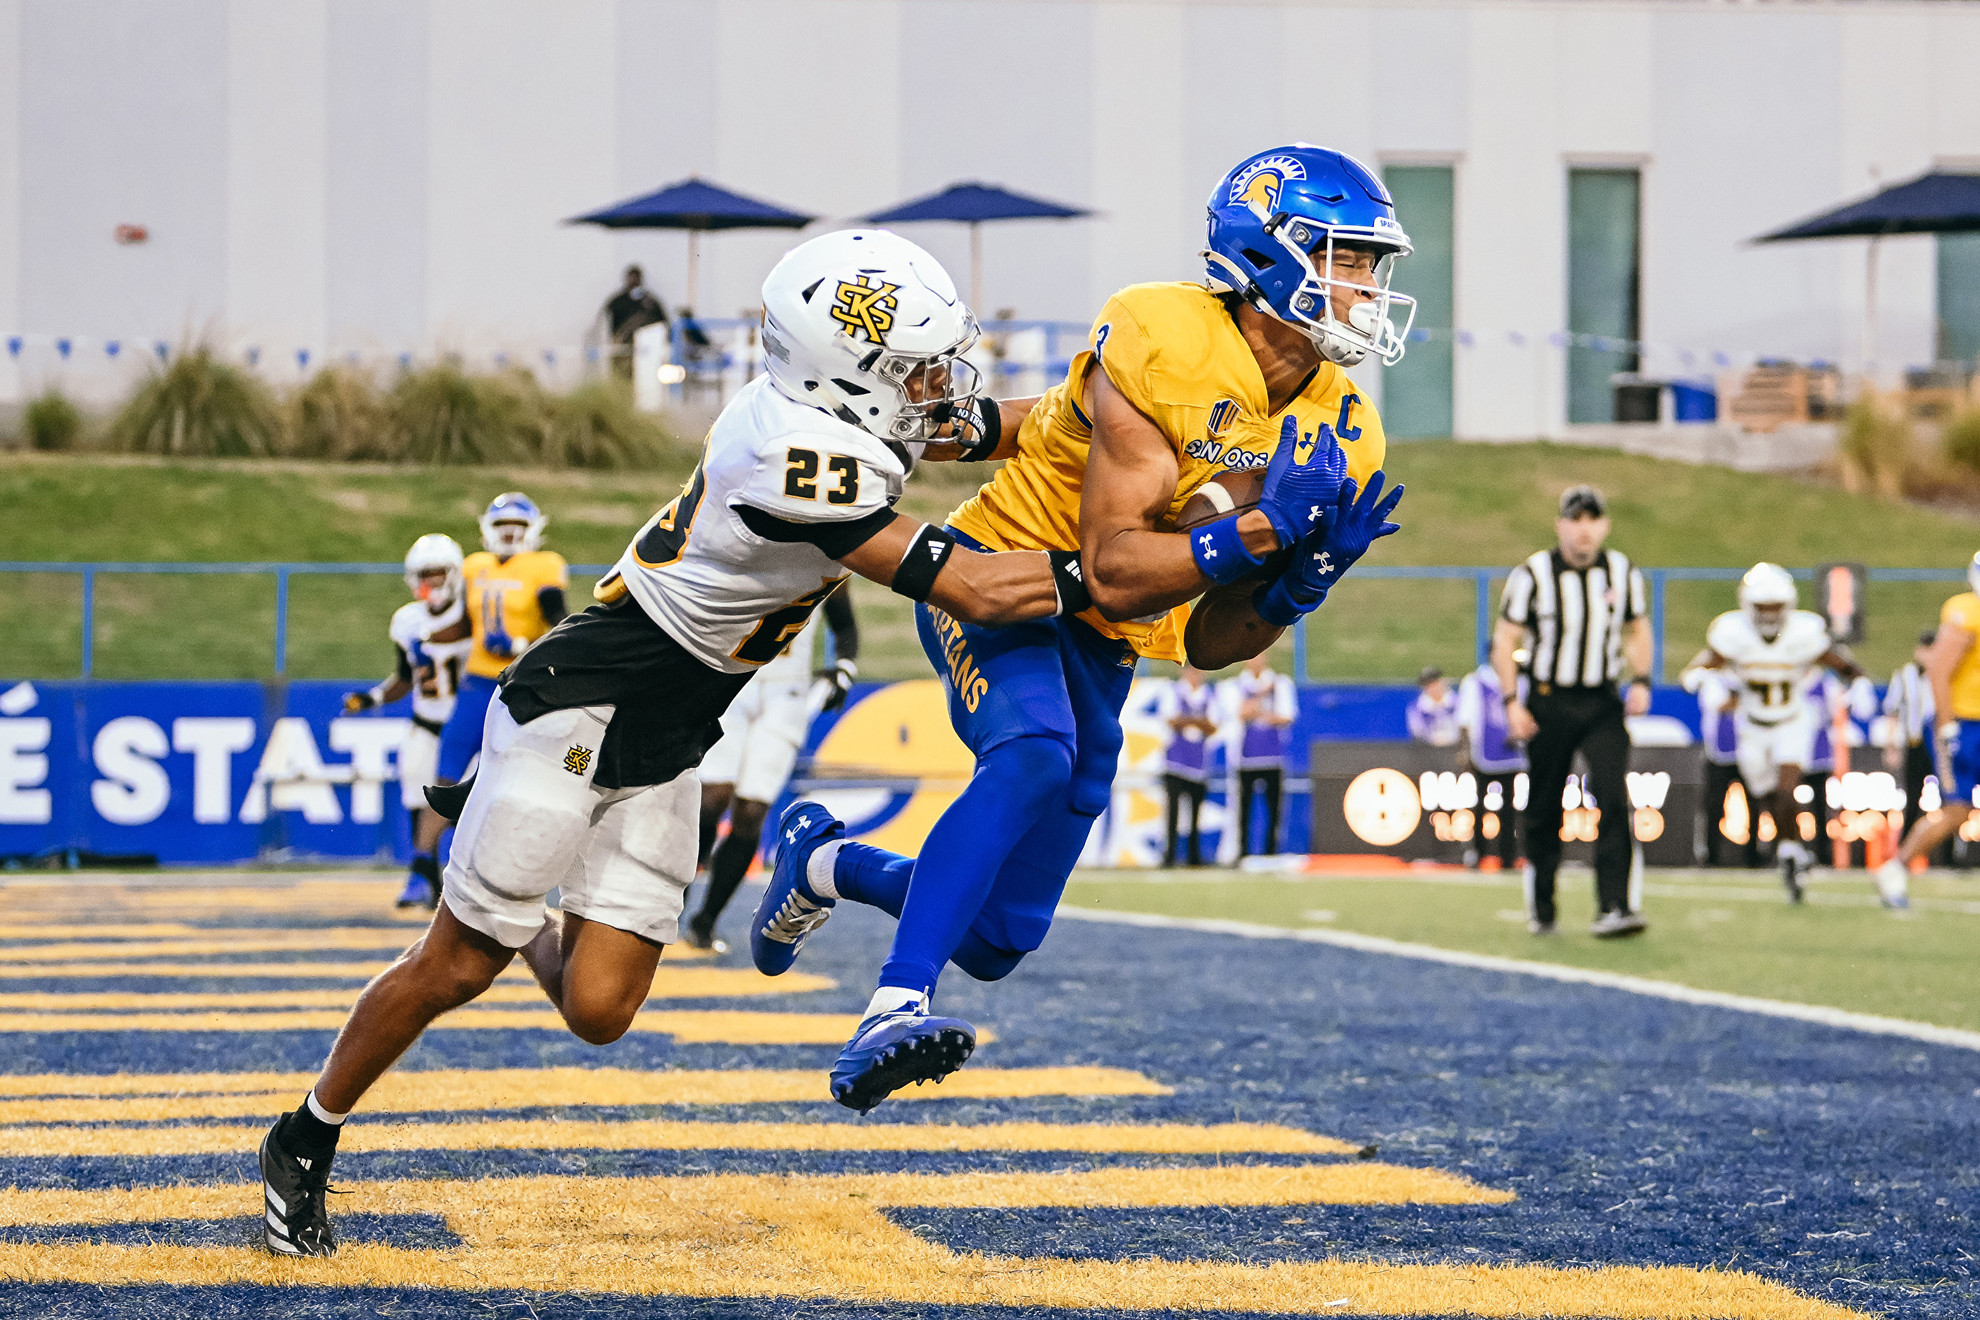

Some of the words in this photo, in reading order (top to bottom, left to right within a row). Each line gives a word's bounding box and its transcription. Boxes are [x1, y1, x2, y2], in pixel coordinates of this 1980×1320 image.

[1335, 393, 1363, 442] C
[784, 445, 860, 506] 23
[1184, 439, 1223, 464] SN
[91, 716, 408, 825] STAT
